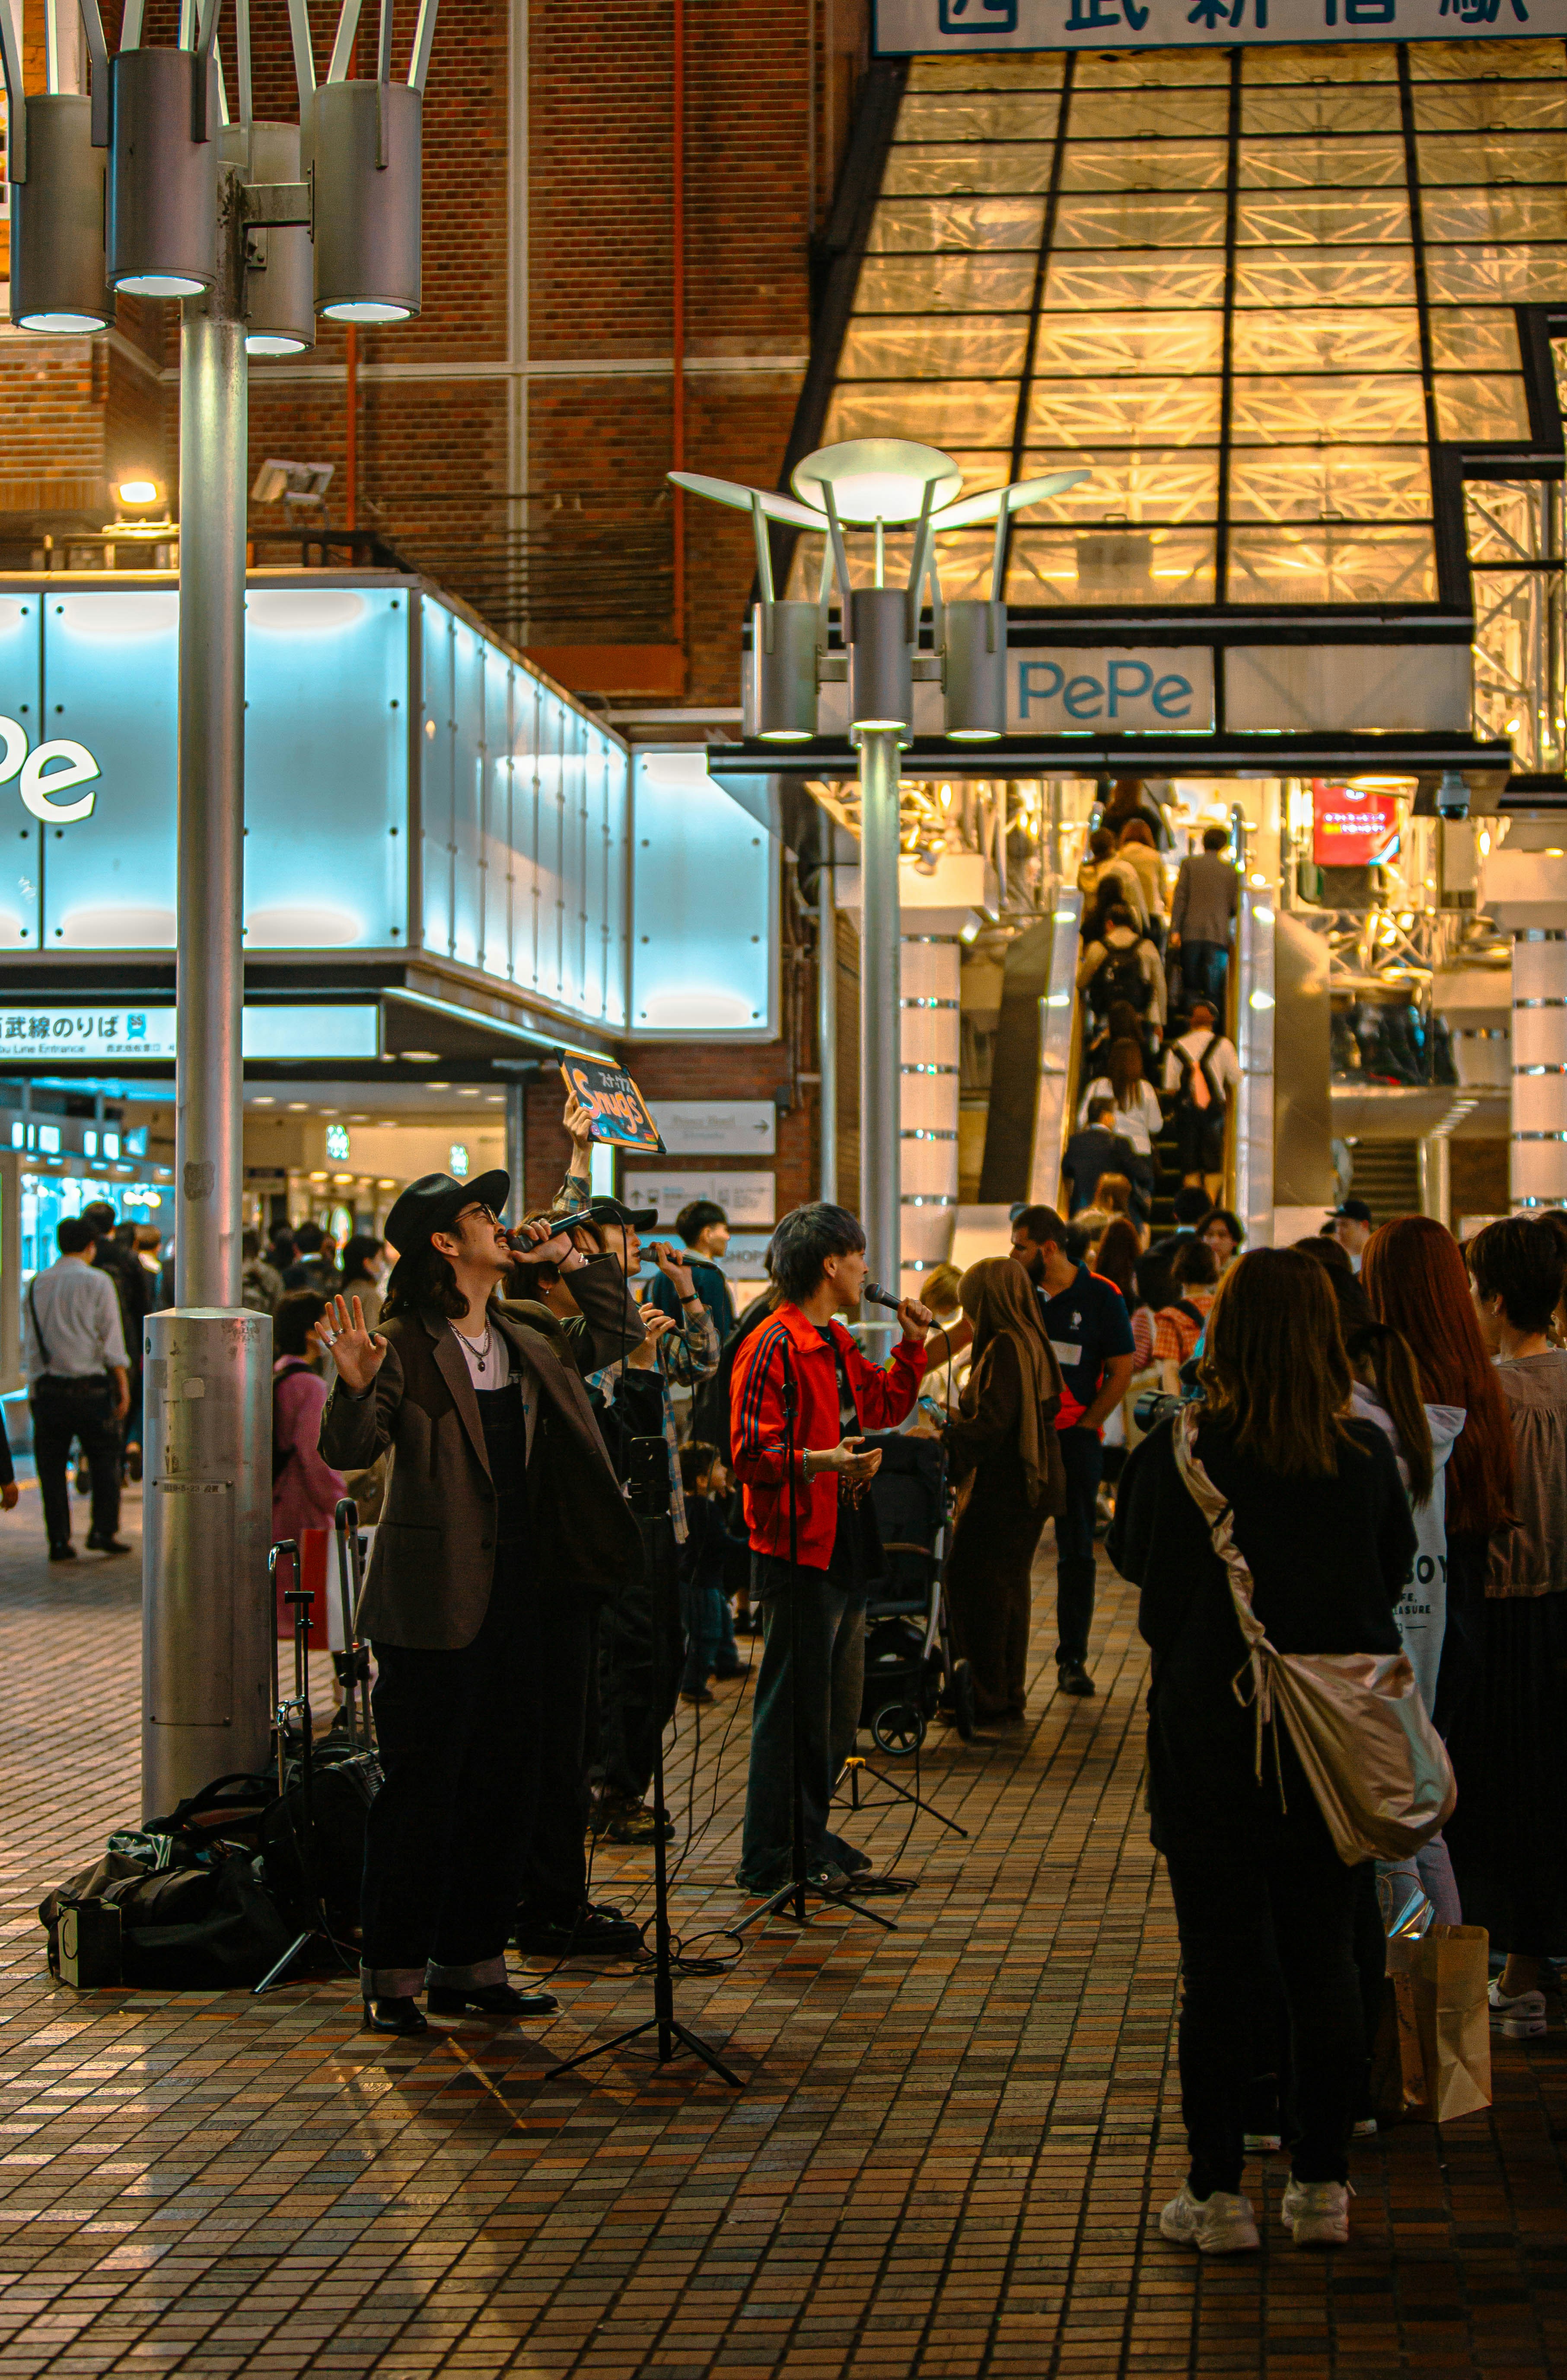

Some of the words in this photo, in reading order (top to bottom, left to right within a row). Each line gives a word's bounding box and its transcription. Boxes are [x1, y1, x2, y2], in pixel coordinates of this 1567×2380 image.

[1018, 660, 1194, 719] PePe
[0, 1016, 118, 1039] 武線のりば
[573, 1068, 644, 1134] Snugs
